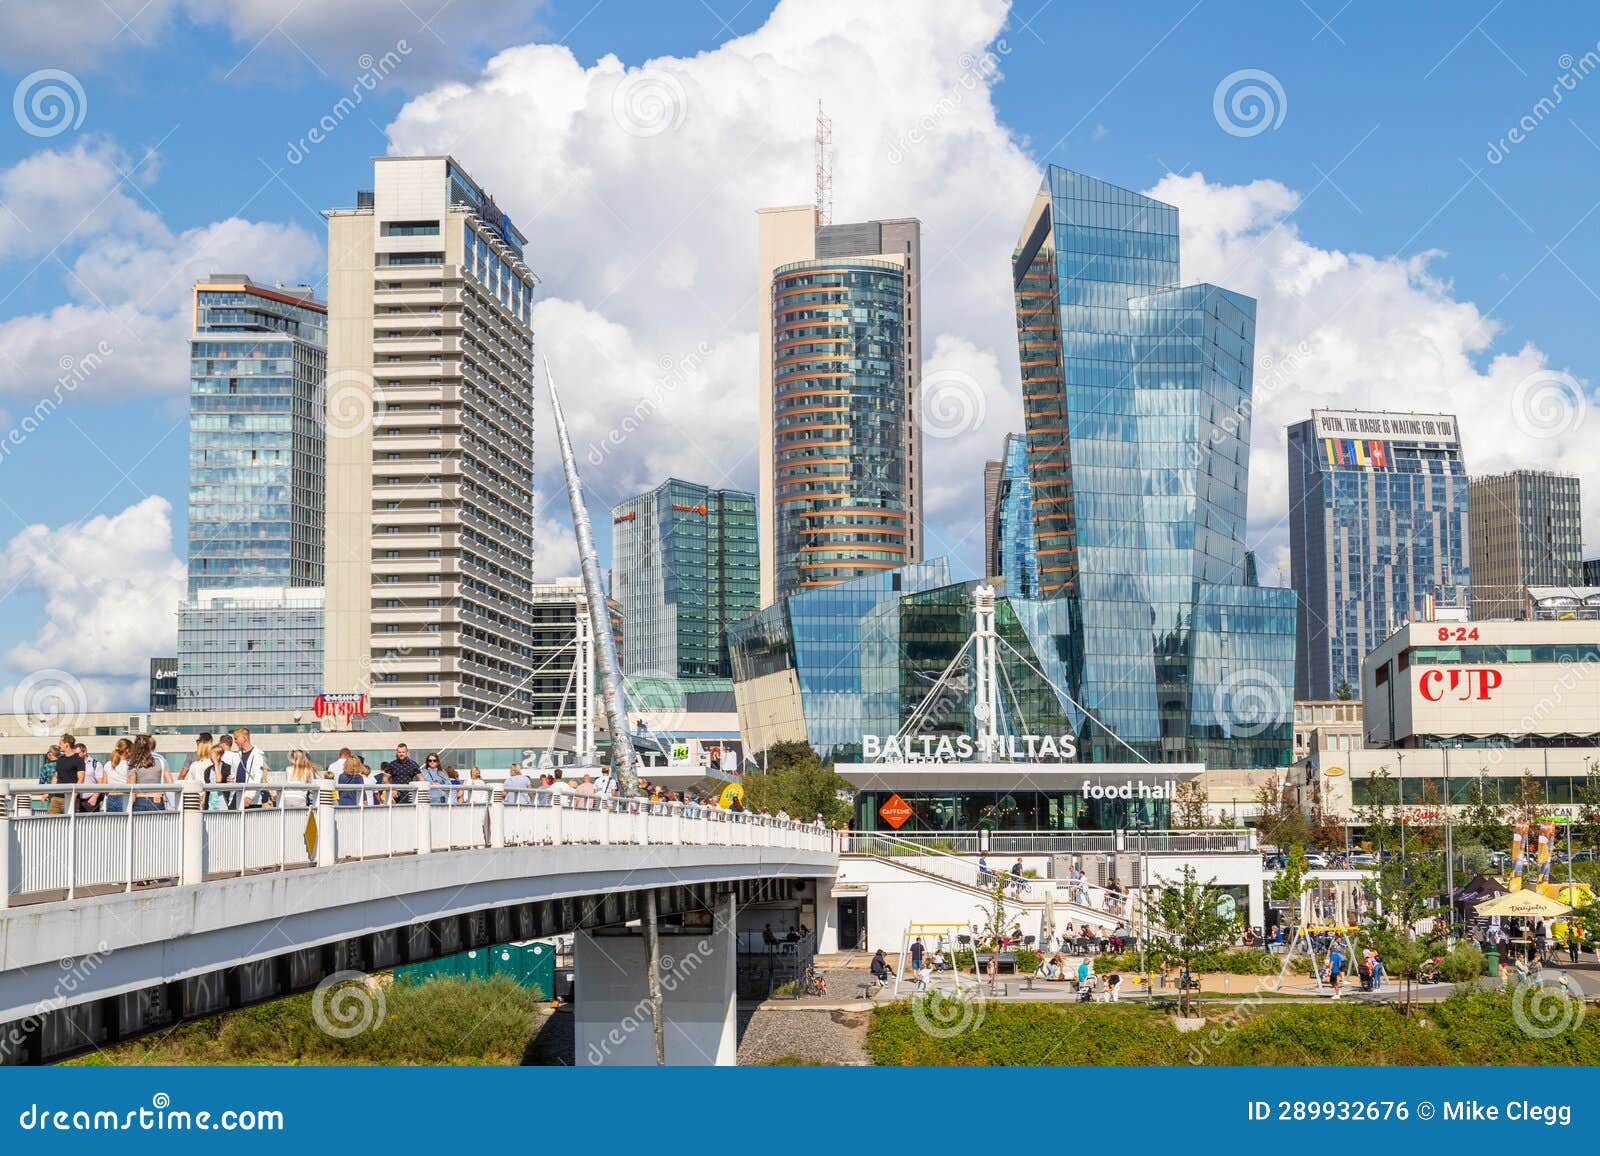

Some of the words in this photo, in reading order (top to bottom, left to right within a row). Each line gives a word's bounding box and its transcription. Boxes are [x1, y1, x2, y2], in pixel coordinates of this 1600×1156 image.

[1344, 417, 1358, 433] THE
[1358, 418, 1382, 434] HAGUE
[1382, 419, 1391, 434] IS
[1391, 419, 1421, 434] WAITING
[1421, 420, 1436, 435] FOR
[1436, 421, 1452, 436] YOU
[1438, 627, 1479, 641] 8-24
[1419, 669, 1502, 701] CUP
[862, 735, 973, 758] BALTAS
[981, 735, 1077, 758] TILTAS
[1082, 780, 1132, 799] food
[1138, 780, 1177, 799] hall
